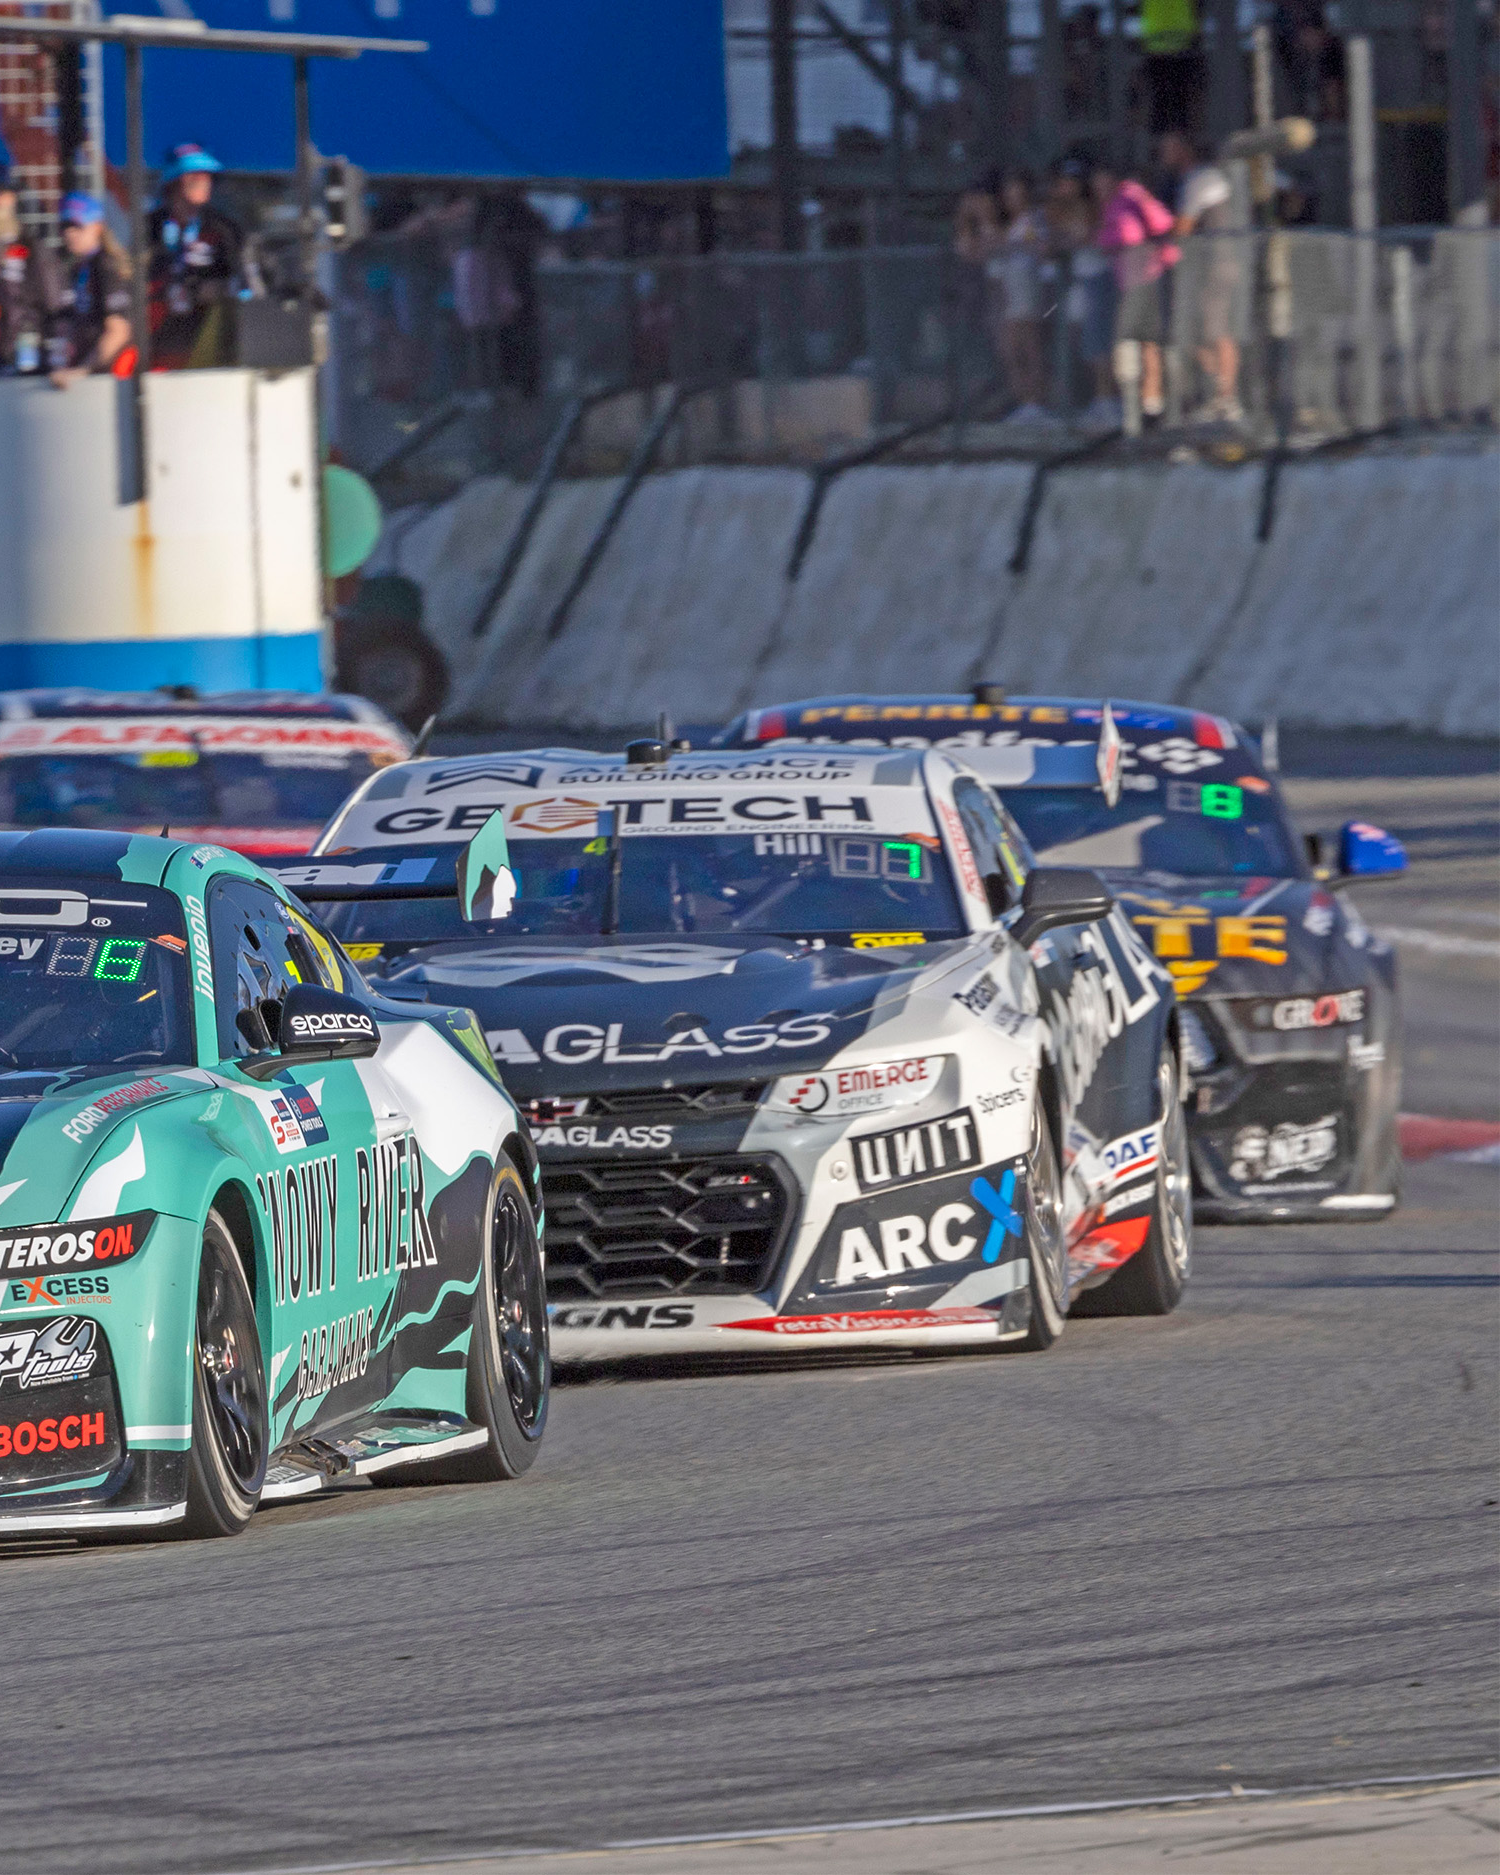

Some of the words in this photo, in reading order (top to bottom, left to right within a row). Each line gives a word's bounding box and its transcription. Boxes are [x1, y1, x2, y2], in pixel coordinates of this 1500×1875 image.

[557, 772, 720, 785] BUILDING
[728, 770, 852, 782] GROUP
[754, 834, 823, 857] Hill
[186, 894, 215, 1004] invenio
[290, 1013, 375, 1036] sparco
[485, 1011, 840, 1064] AGLASS
[837, 1058, 930, 1095] EMERGE
[61, 1104, 104, 1144] FORD
[93, 1076, 171, 1115] PERFORMANCE
[837, 1093, 884, 1109] OFFICE
[858, 1114, 973, 1185] UNIT
[11, 1276, 110, 1306] EXCESS
[66, 1295, 112, 1306] INJECTORS
[21, 1350, 94, 1385] tools
